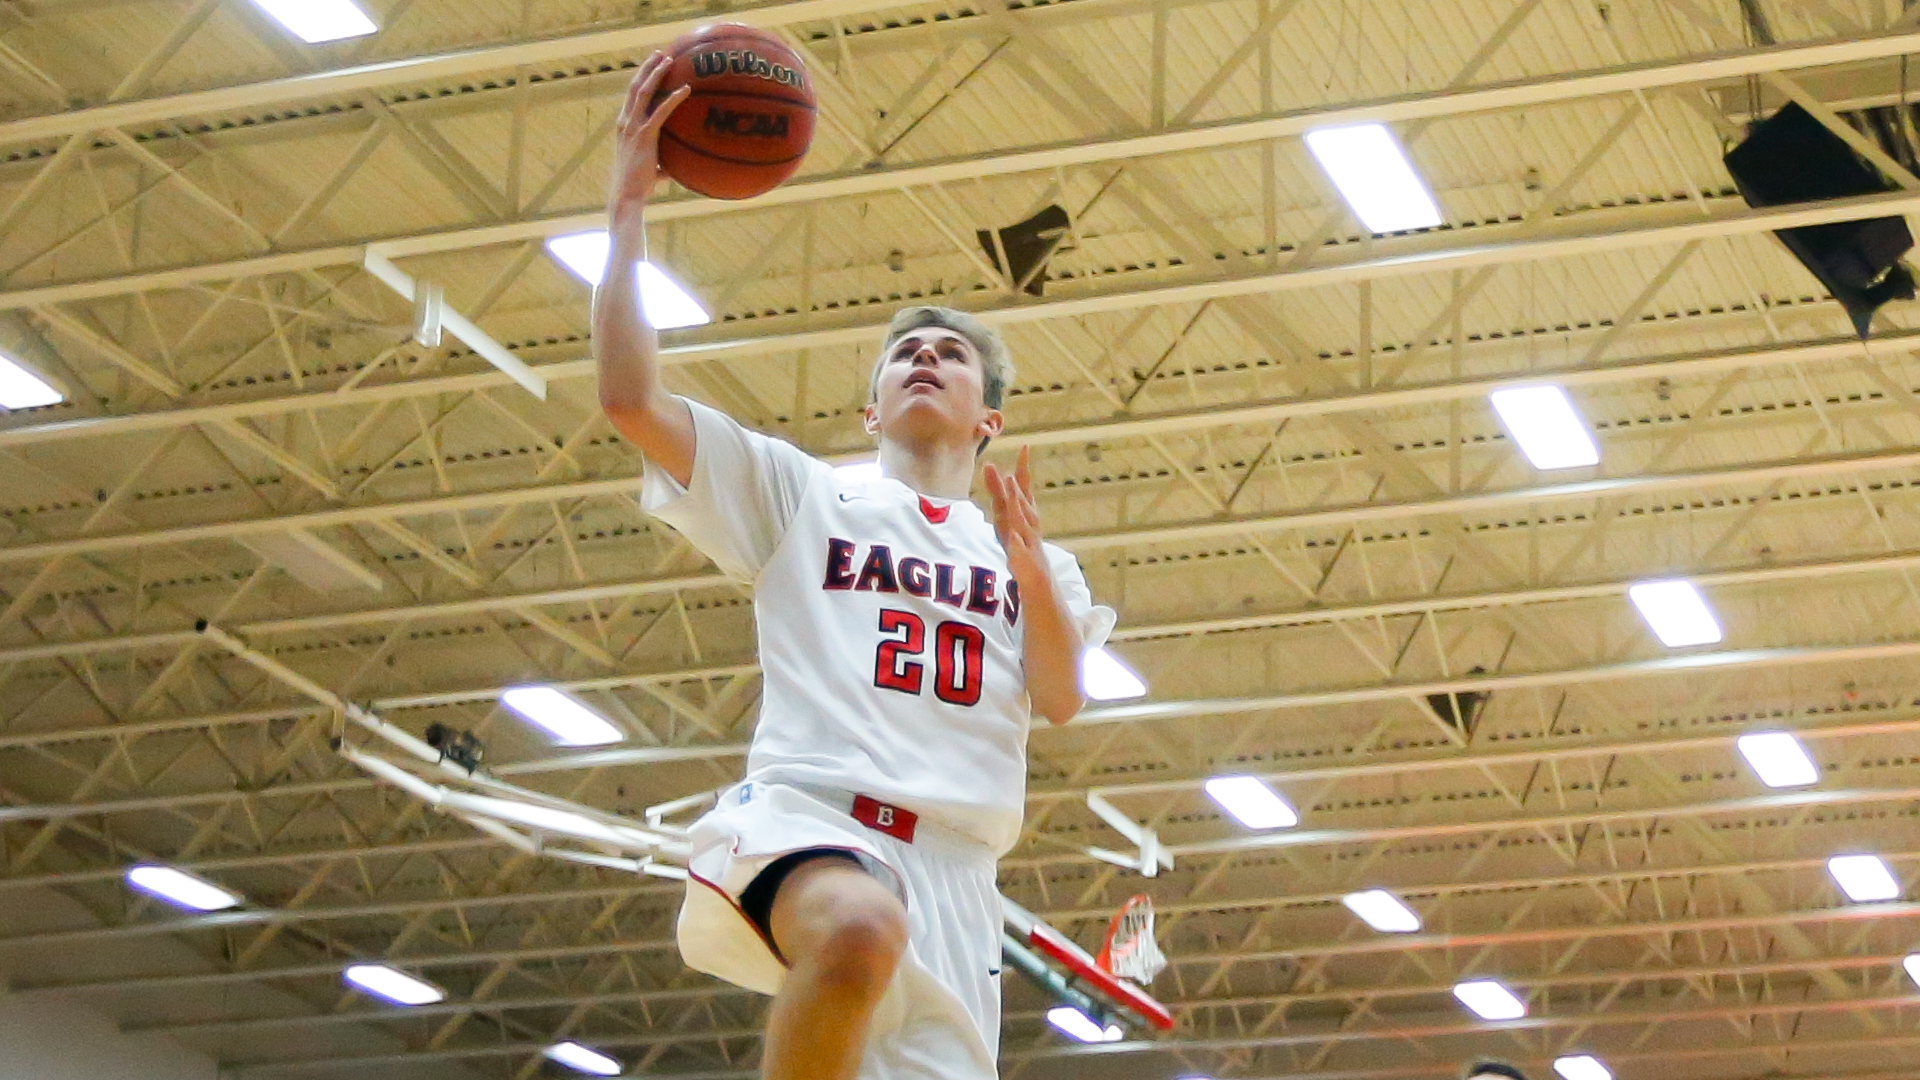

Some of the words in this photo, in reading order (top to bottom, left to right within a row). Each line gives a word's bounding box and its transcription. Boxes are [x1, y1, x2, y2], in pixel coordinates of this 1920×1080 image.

[692, 50, 805, 91] Wilson
[704, 105, 790, 137] NCAA
[873, 608, 985, 706] 20
[877, 805, 895, 827] B
